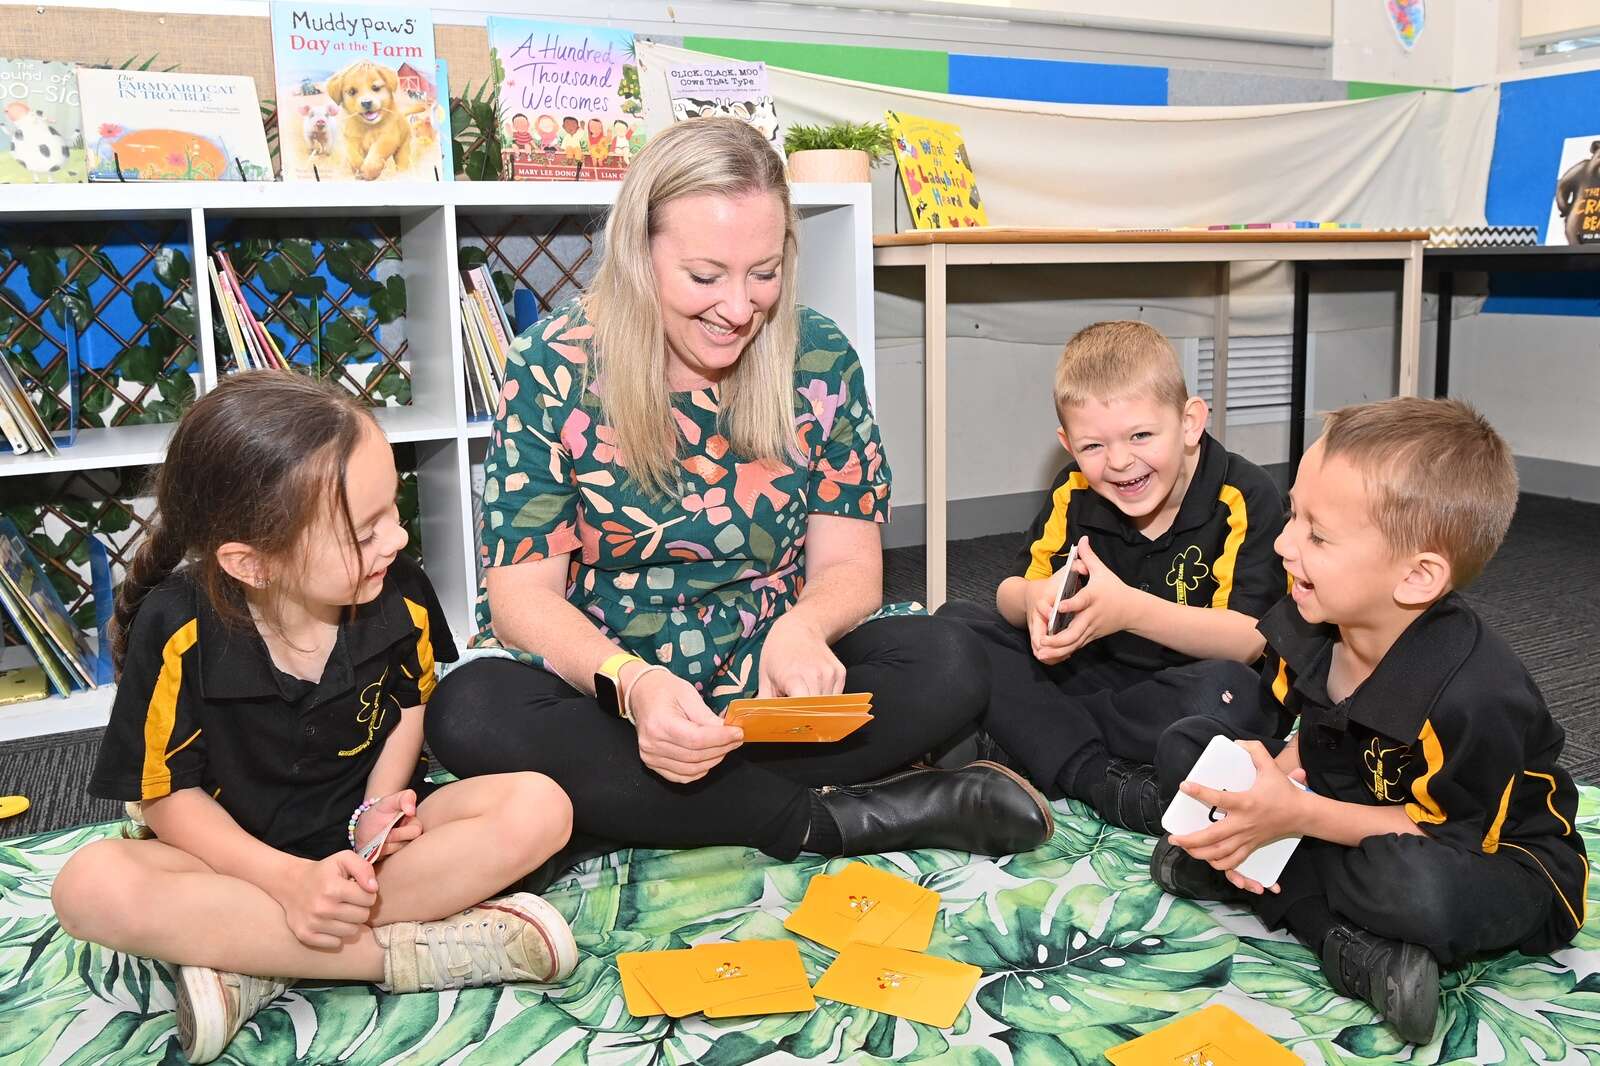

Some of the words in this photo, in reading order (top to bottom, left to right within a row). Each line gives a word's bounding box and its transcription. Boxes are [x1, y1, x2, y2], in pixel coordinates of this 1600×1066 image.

[289, 34, 329, 55] Day
[333, 42, 348, 51] at
[349, 41, 368, 51] the
[372, 41, 424, 57] Farm
[510, 32, 536, 59] A
[538, 33, 615, 65] Hundred
[0, 71, 42, 80] ound
[50, 74, 71, 85] of
[513, 61, 613, 88] Thousand
[731, 78, 754, 87] Type
[118, 81, 204, 93] FARMYARD
[206, 85, 236, 95] CAT
[118, 90, 137, 98] IN
[140, 91, 213, 102] TROUBLE
[521, 84, 609, 112] Welcomes
[918, 164, 967, 191] Ladybird
